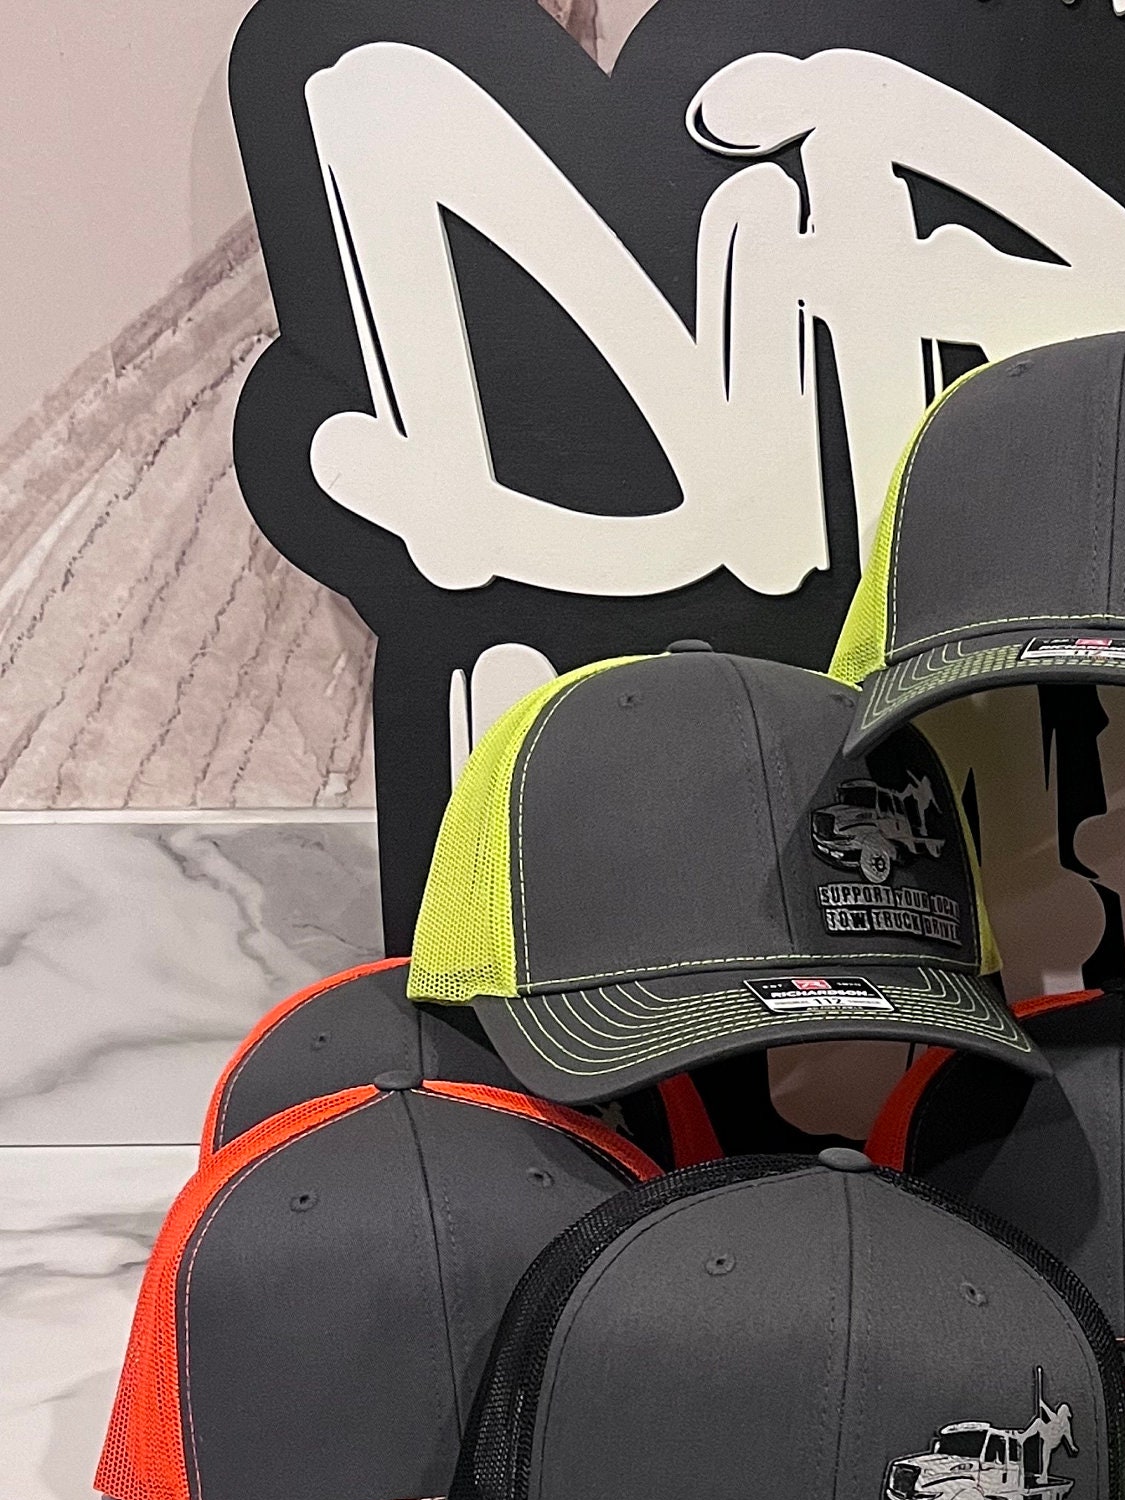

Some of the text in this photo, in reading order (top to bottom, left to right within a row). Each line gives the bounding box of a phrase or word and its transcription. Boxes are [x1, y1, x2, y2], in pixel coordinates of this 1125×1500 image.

[821, 886, 892, 904] SUPPORT
[827, 911, 868, 929] TOW
[873, 911, 921, 931] TRUCK
